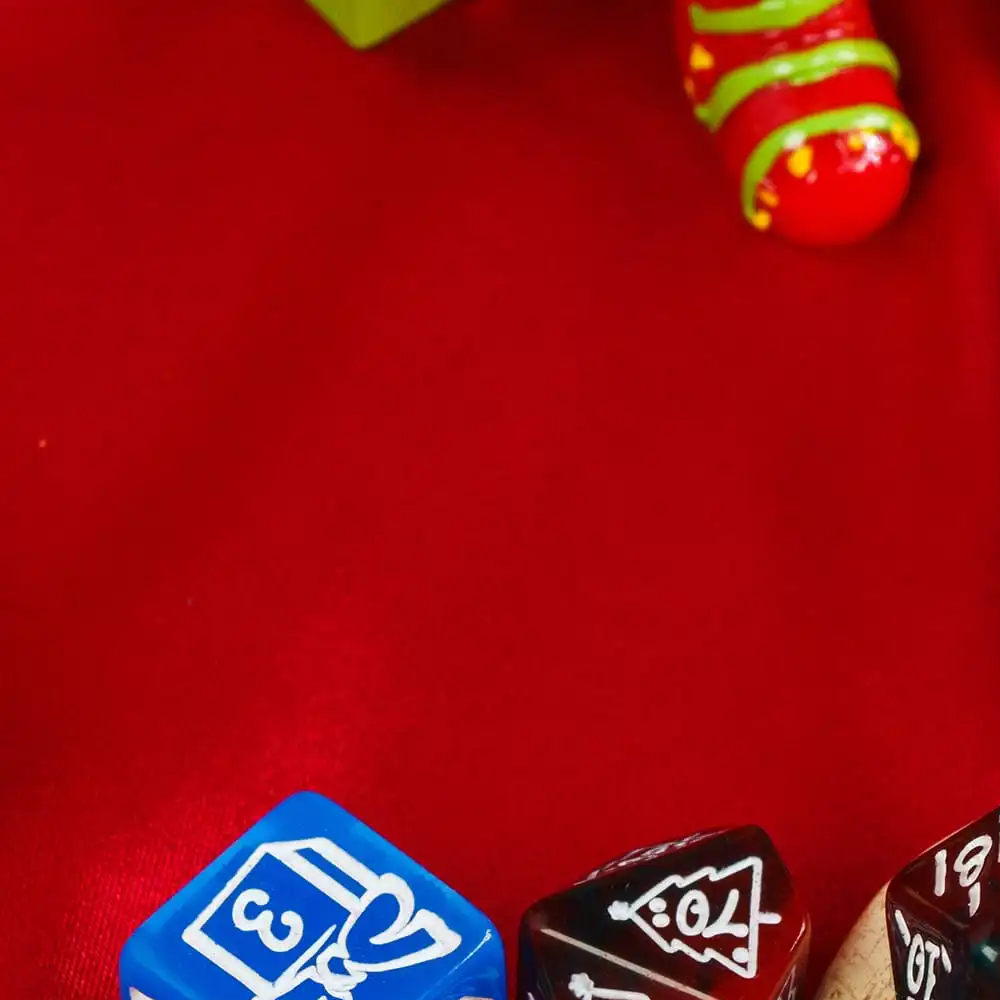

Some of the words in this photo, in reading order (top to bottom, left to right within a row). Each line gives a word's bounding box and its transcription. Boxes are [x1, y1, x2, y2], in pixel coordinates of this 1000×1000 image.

[953, 834, 993, 888] 8
[231, 888, 304, 953] 3
[676, 888, 749, 938] 70
